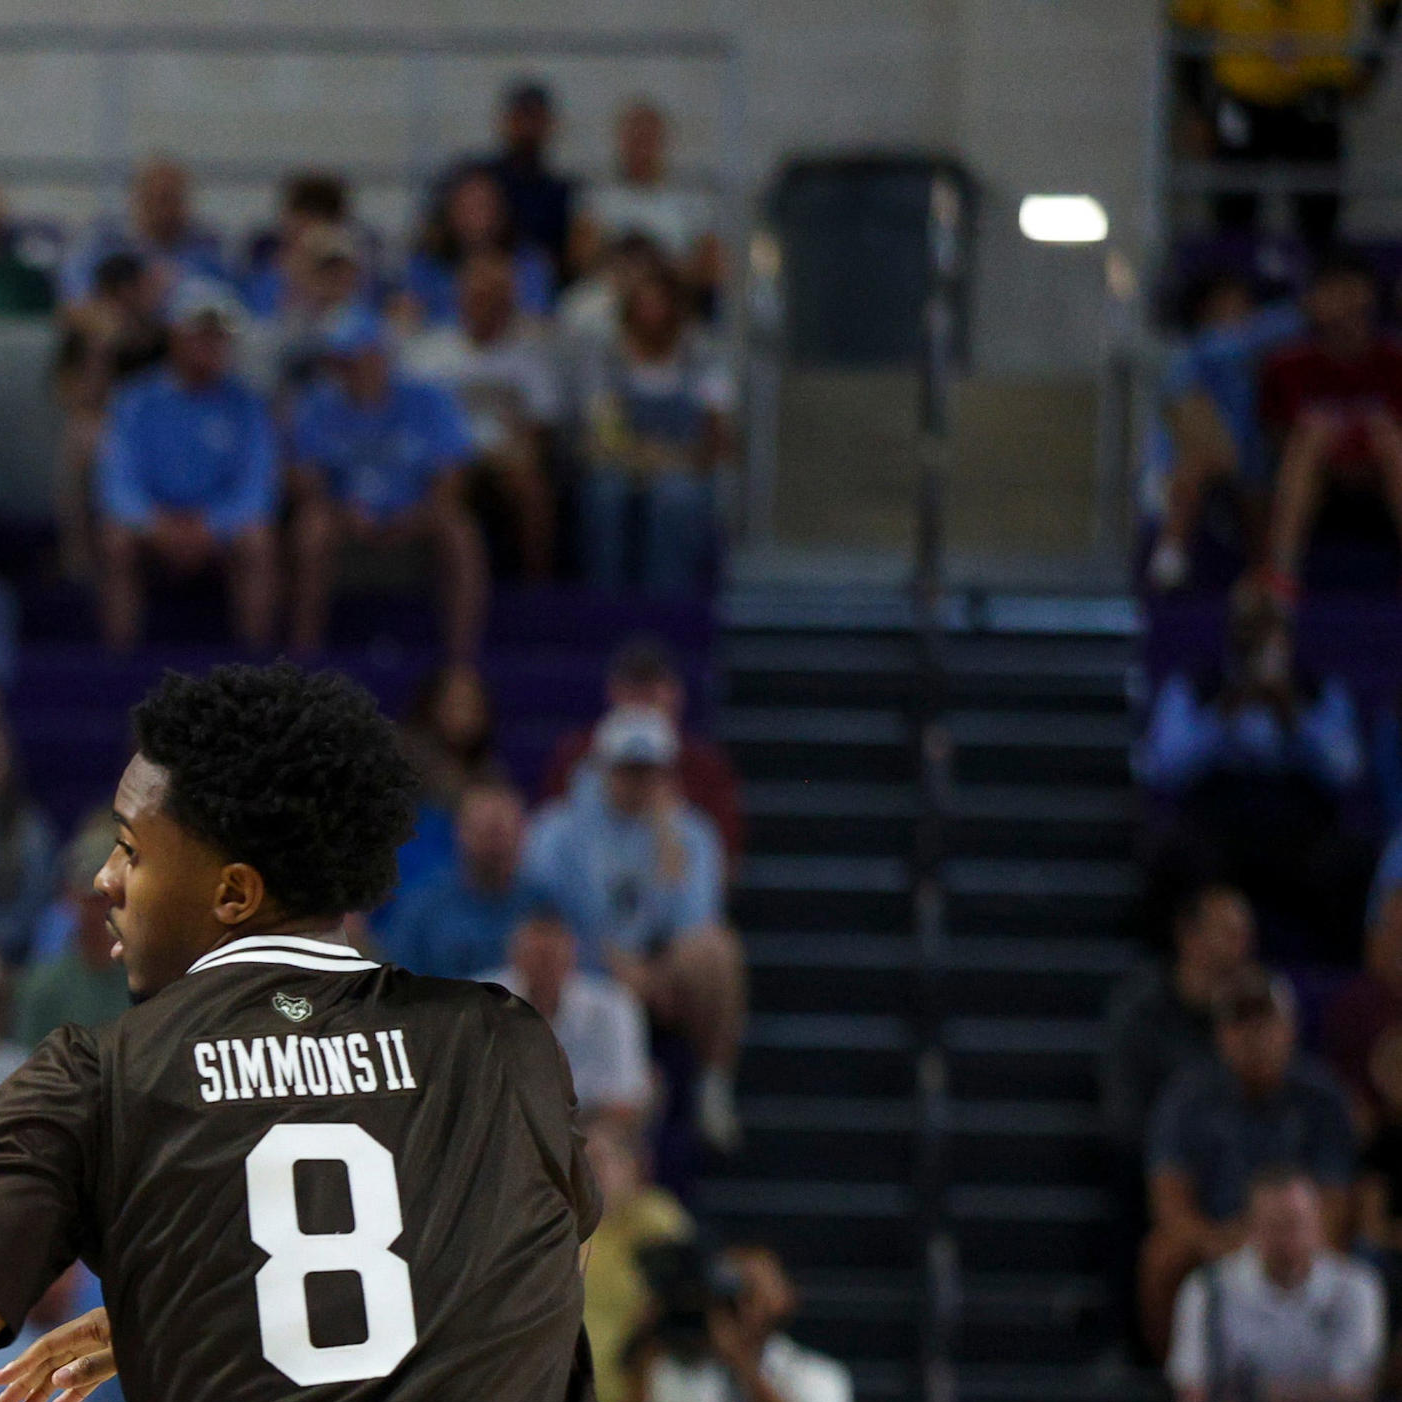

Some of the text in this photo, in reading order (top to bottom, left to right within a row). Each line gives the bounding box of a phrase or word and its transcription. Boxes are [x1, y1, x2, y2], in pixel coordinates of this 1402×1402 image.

[194, 1029, 417, 1103] SIMMONS II
[244, 1122, 418, 1387] 8
